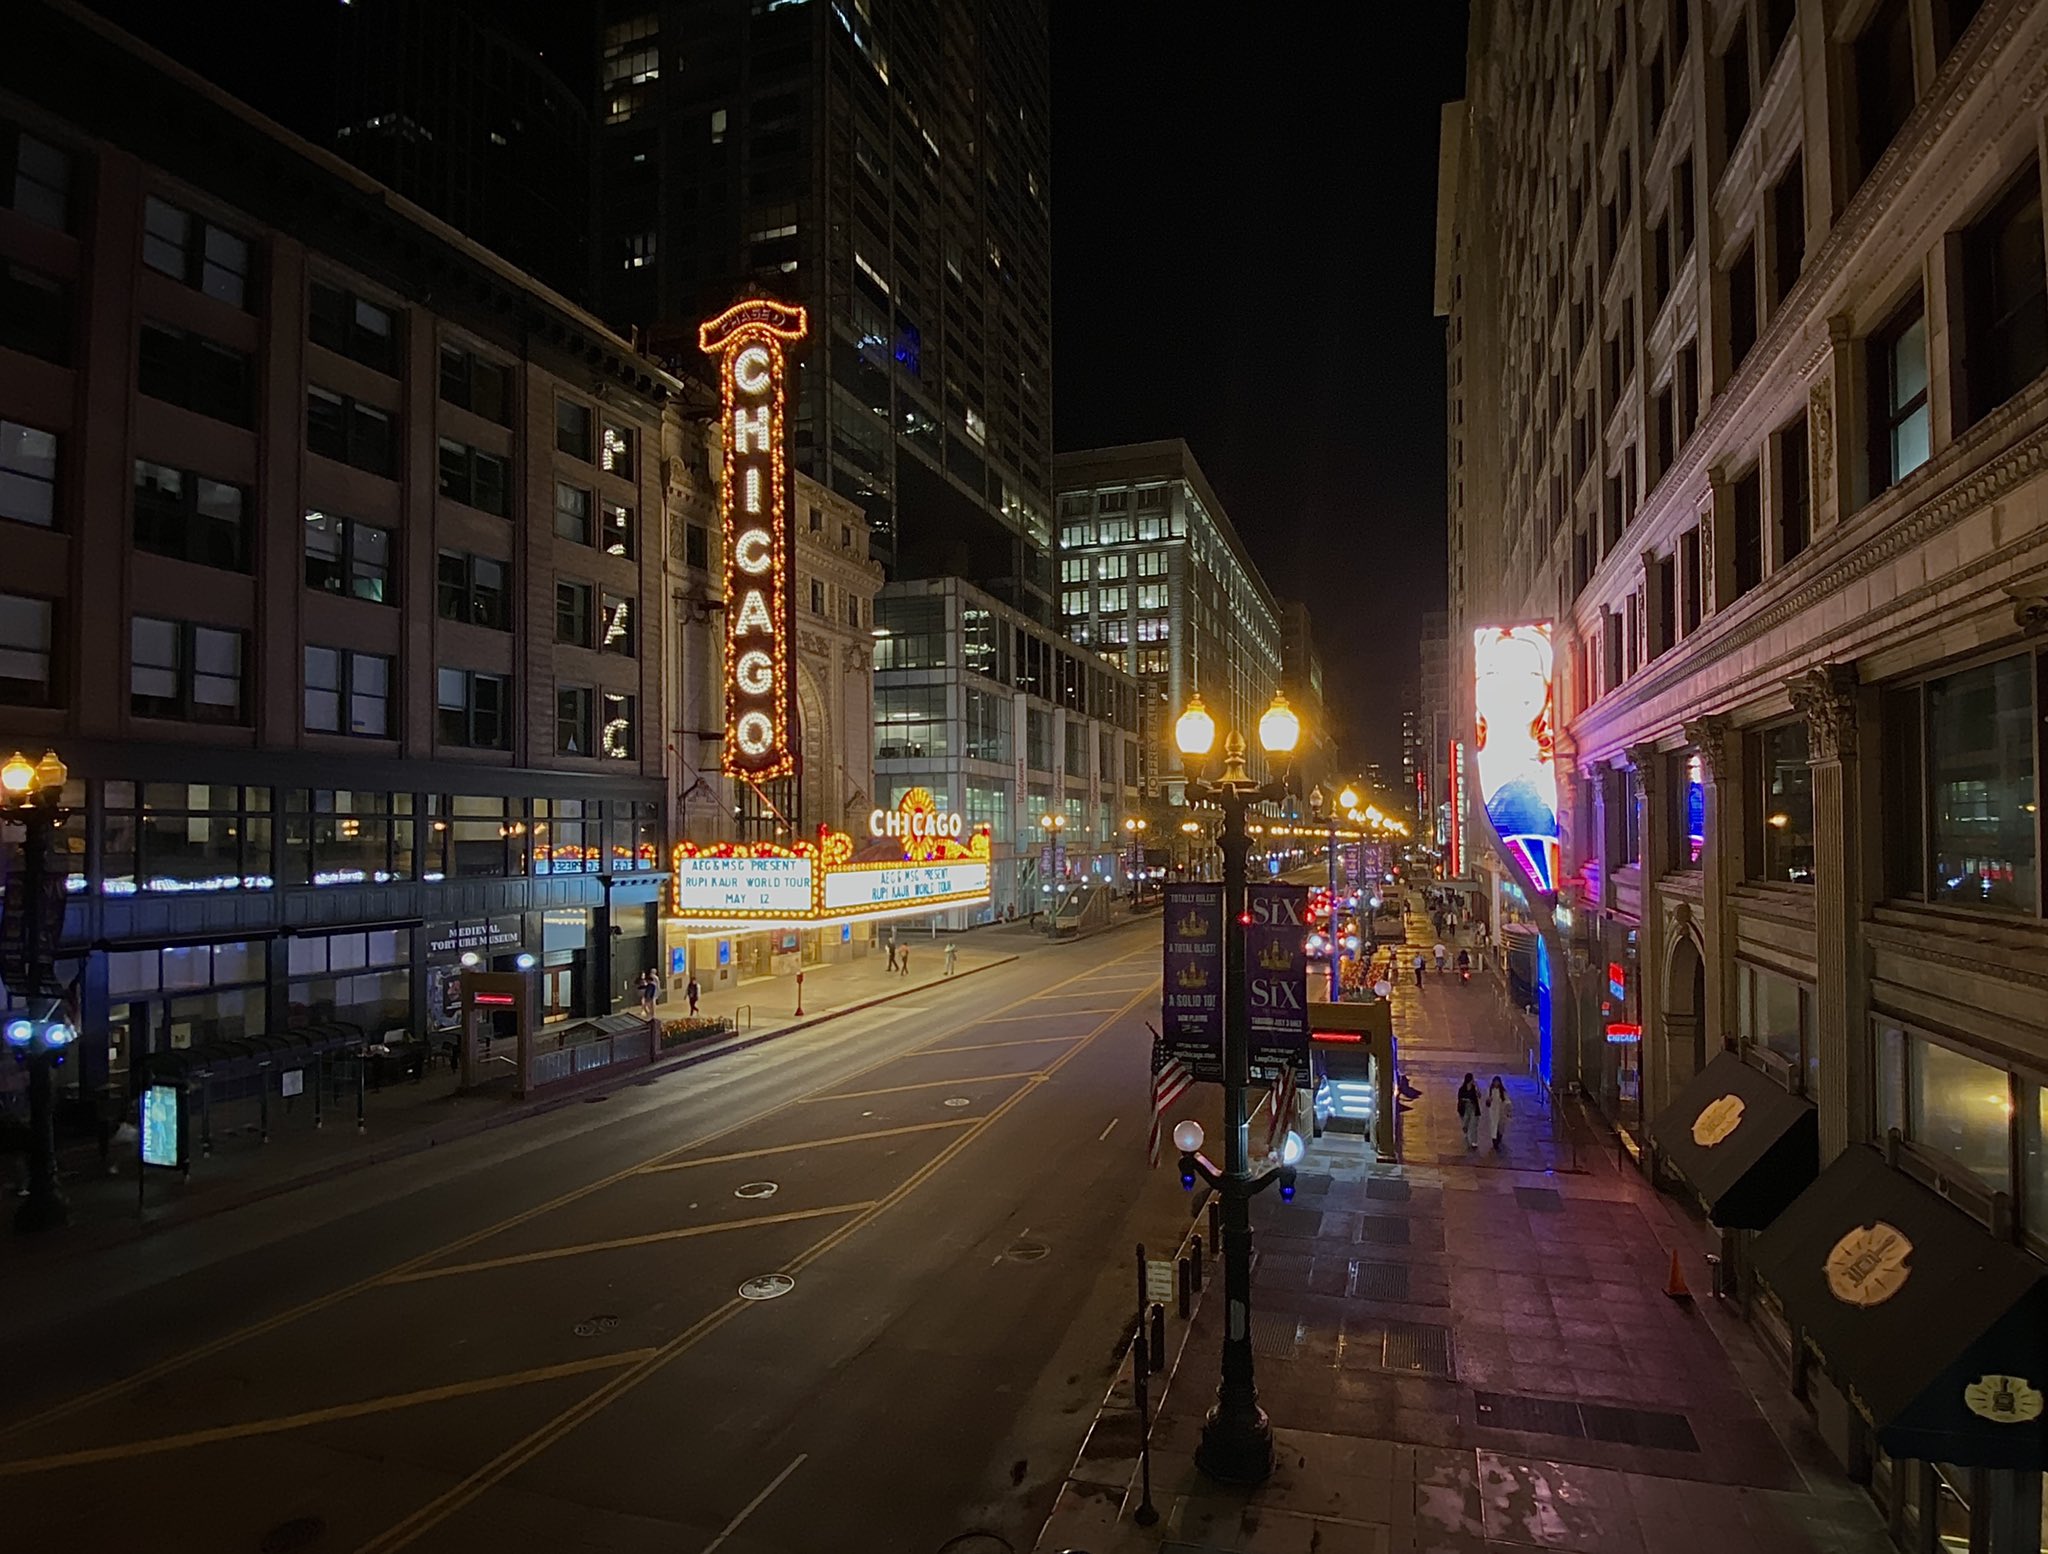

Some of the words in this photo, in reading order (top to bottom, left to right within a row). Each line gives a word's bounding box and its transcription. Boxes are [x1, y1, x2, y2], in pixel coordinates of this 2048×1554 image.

[734, 347, 773, 756] CHICAGO
[1149, 685, 1158, 735] BALLET
[1149, 737, 1158, 795] JOFFREY
[870, 809, 962, 837] CHICAGO
[751, 860, 796, 871] PRESENT
[685, 877, 708, 887] RUPI
[711, 877, 738, 887] KAUR
[746, 877, 780, 887] WORLD
[784, 877, 810, 887] TOUR
[725, 894, 746, 904] MAY
[760, 894, 769, 904] 12
[448, 924, 500, 938] MEDIEVAL
[431, 937, 478, 951] TORTURE
[479, 933, 518, 946] MUSEUM
[1176, 995, 1200, 1007] SOLID
